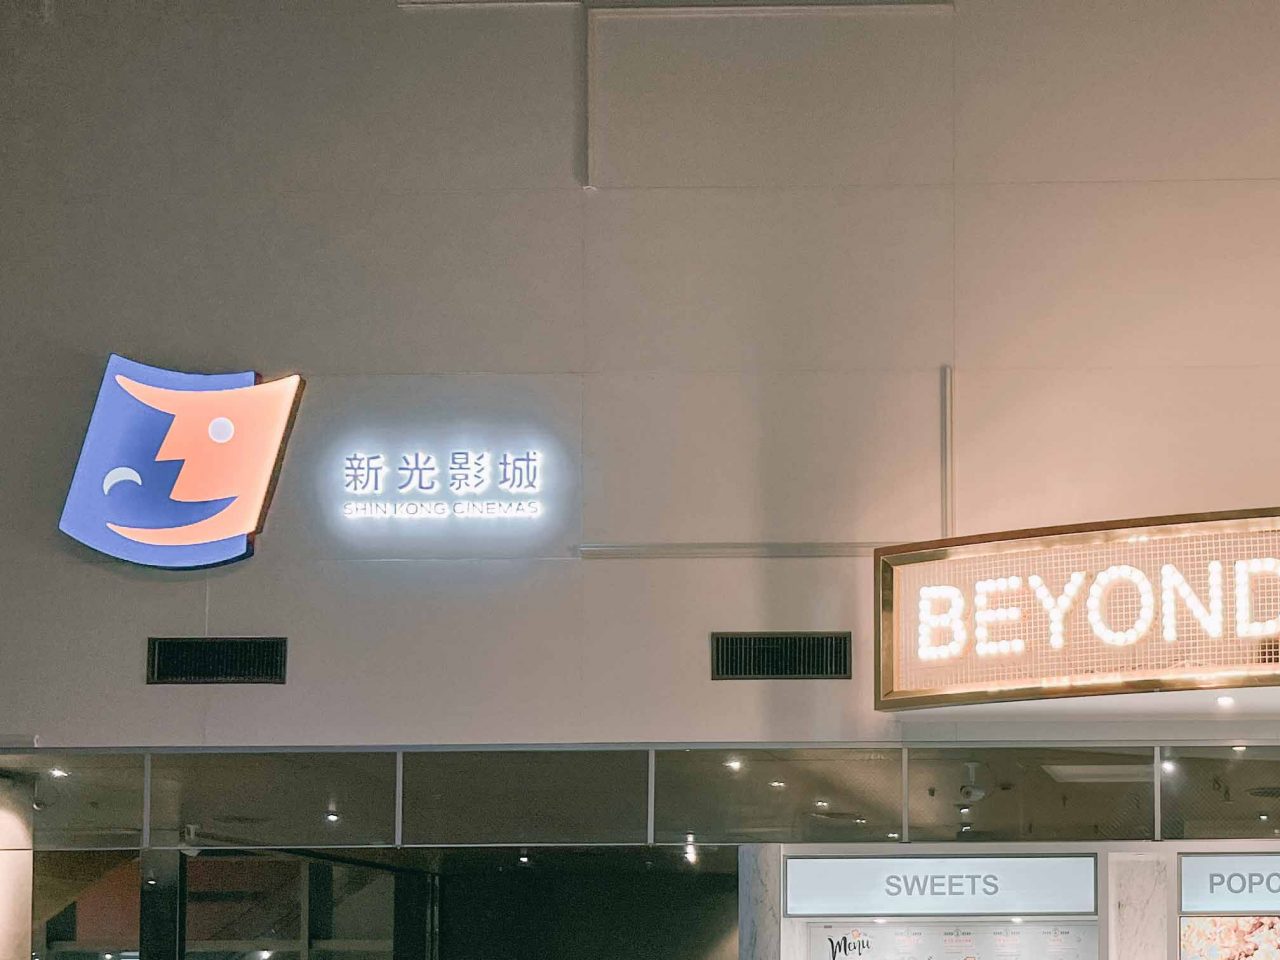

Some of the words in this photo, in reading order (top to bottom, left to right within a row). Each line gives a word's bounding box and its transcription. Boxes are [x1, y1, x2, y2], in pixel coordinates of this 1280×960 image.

[344, 451, 537, 491] 新光影城
[343, 502, 387, 515] SHIN
[394, 502, 446, 515] KONG
[452, 501, 539, 515] CINEMAS
[884, 874, 1000, 897] SWEETS
[827, 936, 872, 960] Menu
